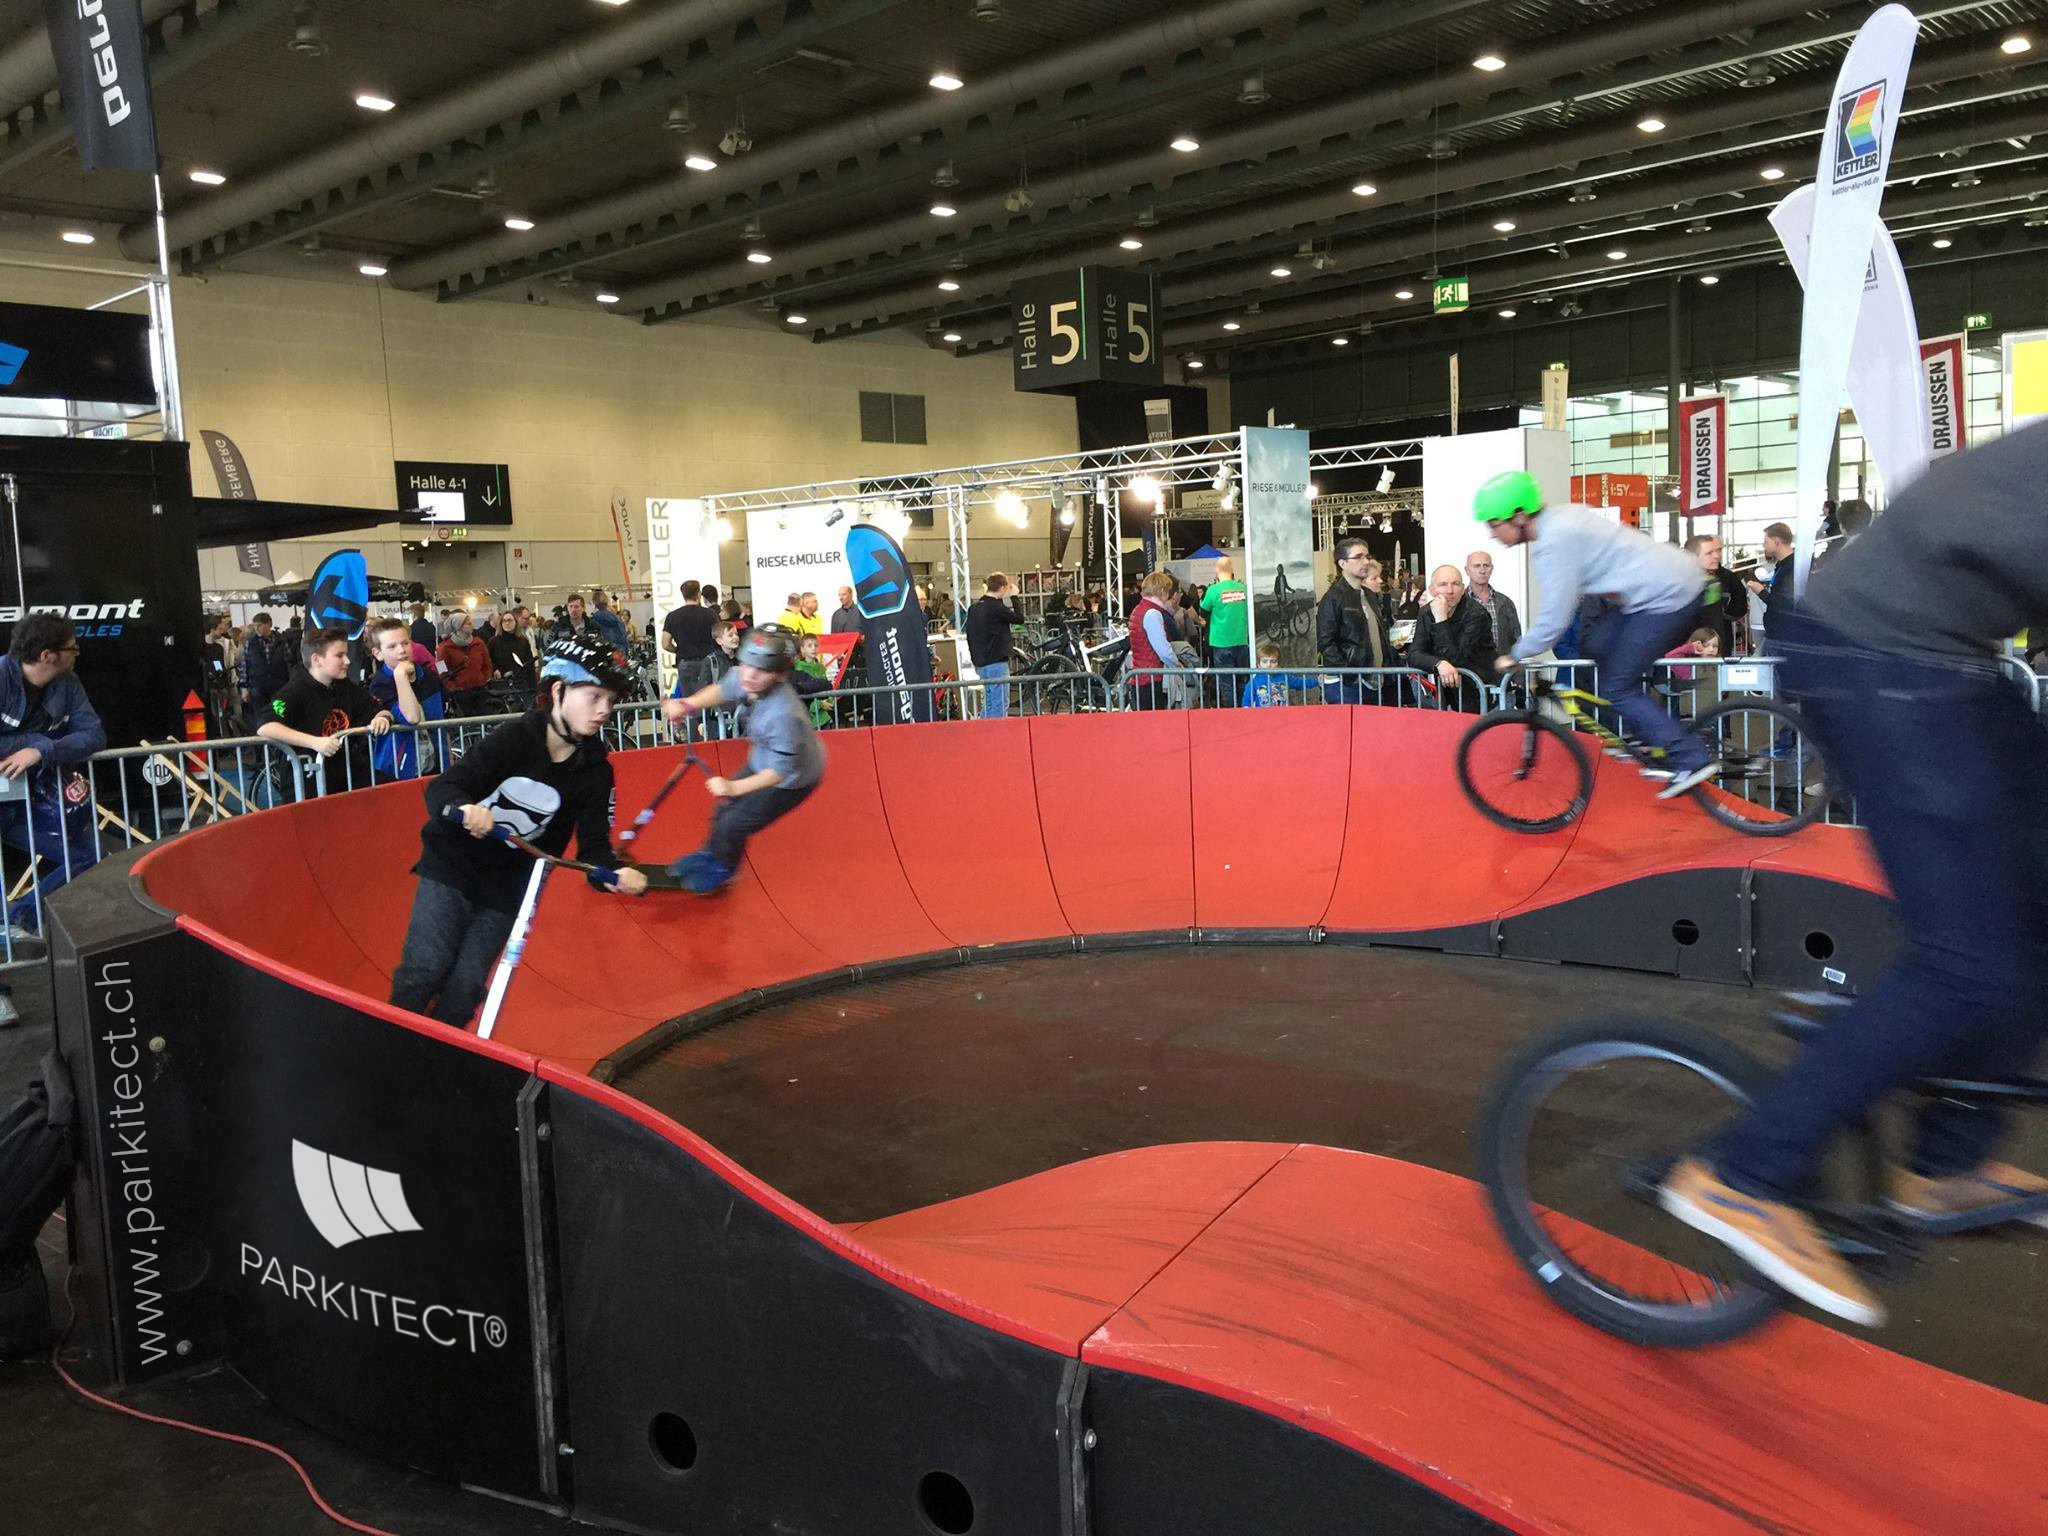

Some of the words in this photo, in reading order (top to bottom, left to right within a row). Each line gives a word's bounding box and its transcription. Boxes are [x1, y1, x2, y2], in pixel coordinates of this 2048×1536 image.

[1836, 152, 1878, 177] KETTLER
[1018, 303, 1037, 371] Halle
[1050, 300, 1080, 365] 5
[1103, 292, 1118, 361] Halle
[1127, 302, 1150, 364] 5
[1929, 361, 1951, 450] DRAUSSEN
[410, 475, 446, 489] Halle
[1696, 417, 1711, 500] DRAUSSEN
[94, 960, 168, 1366] www.parkitect.ch
